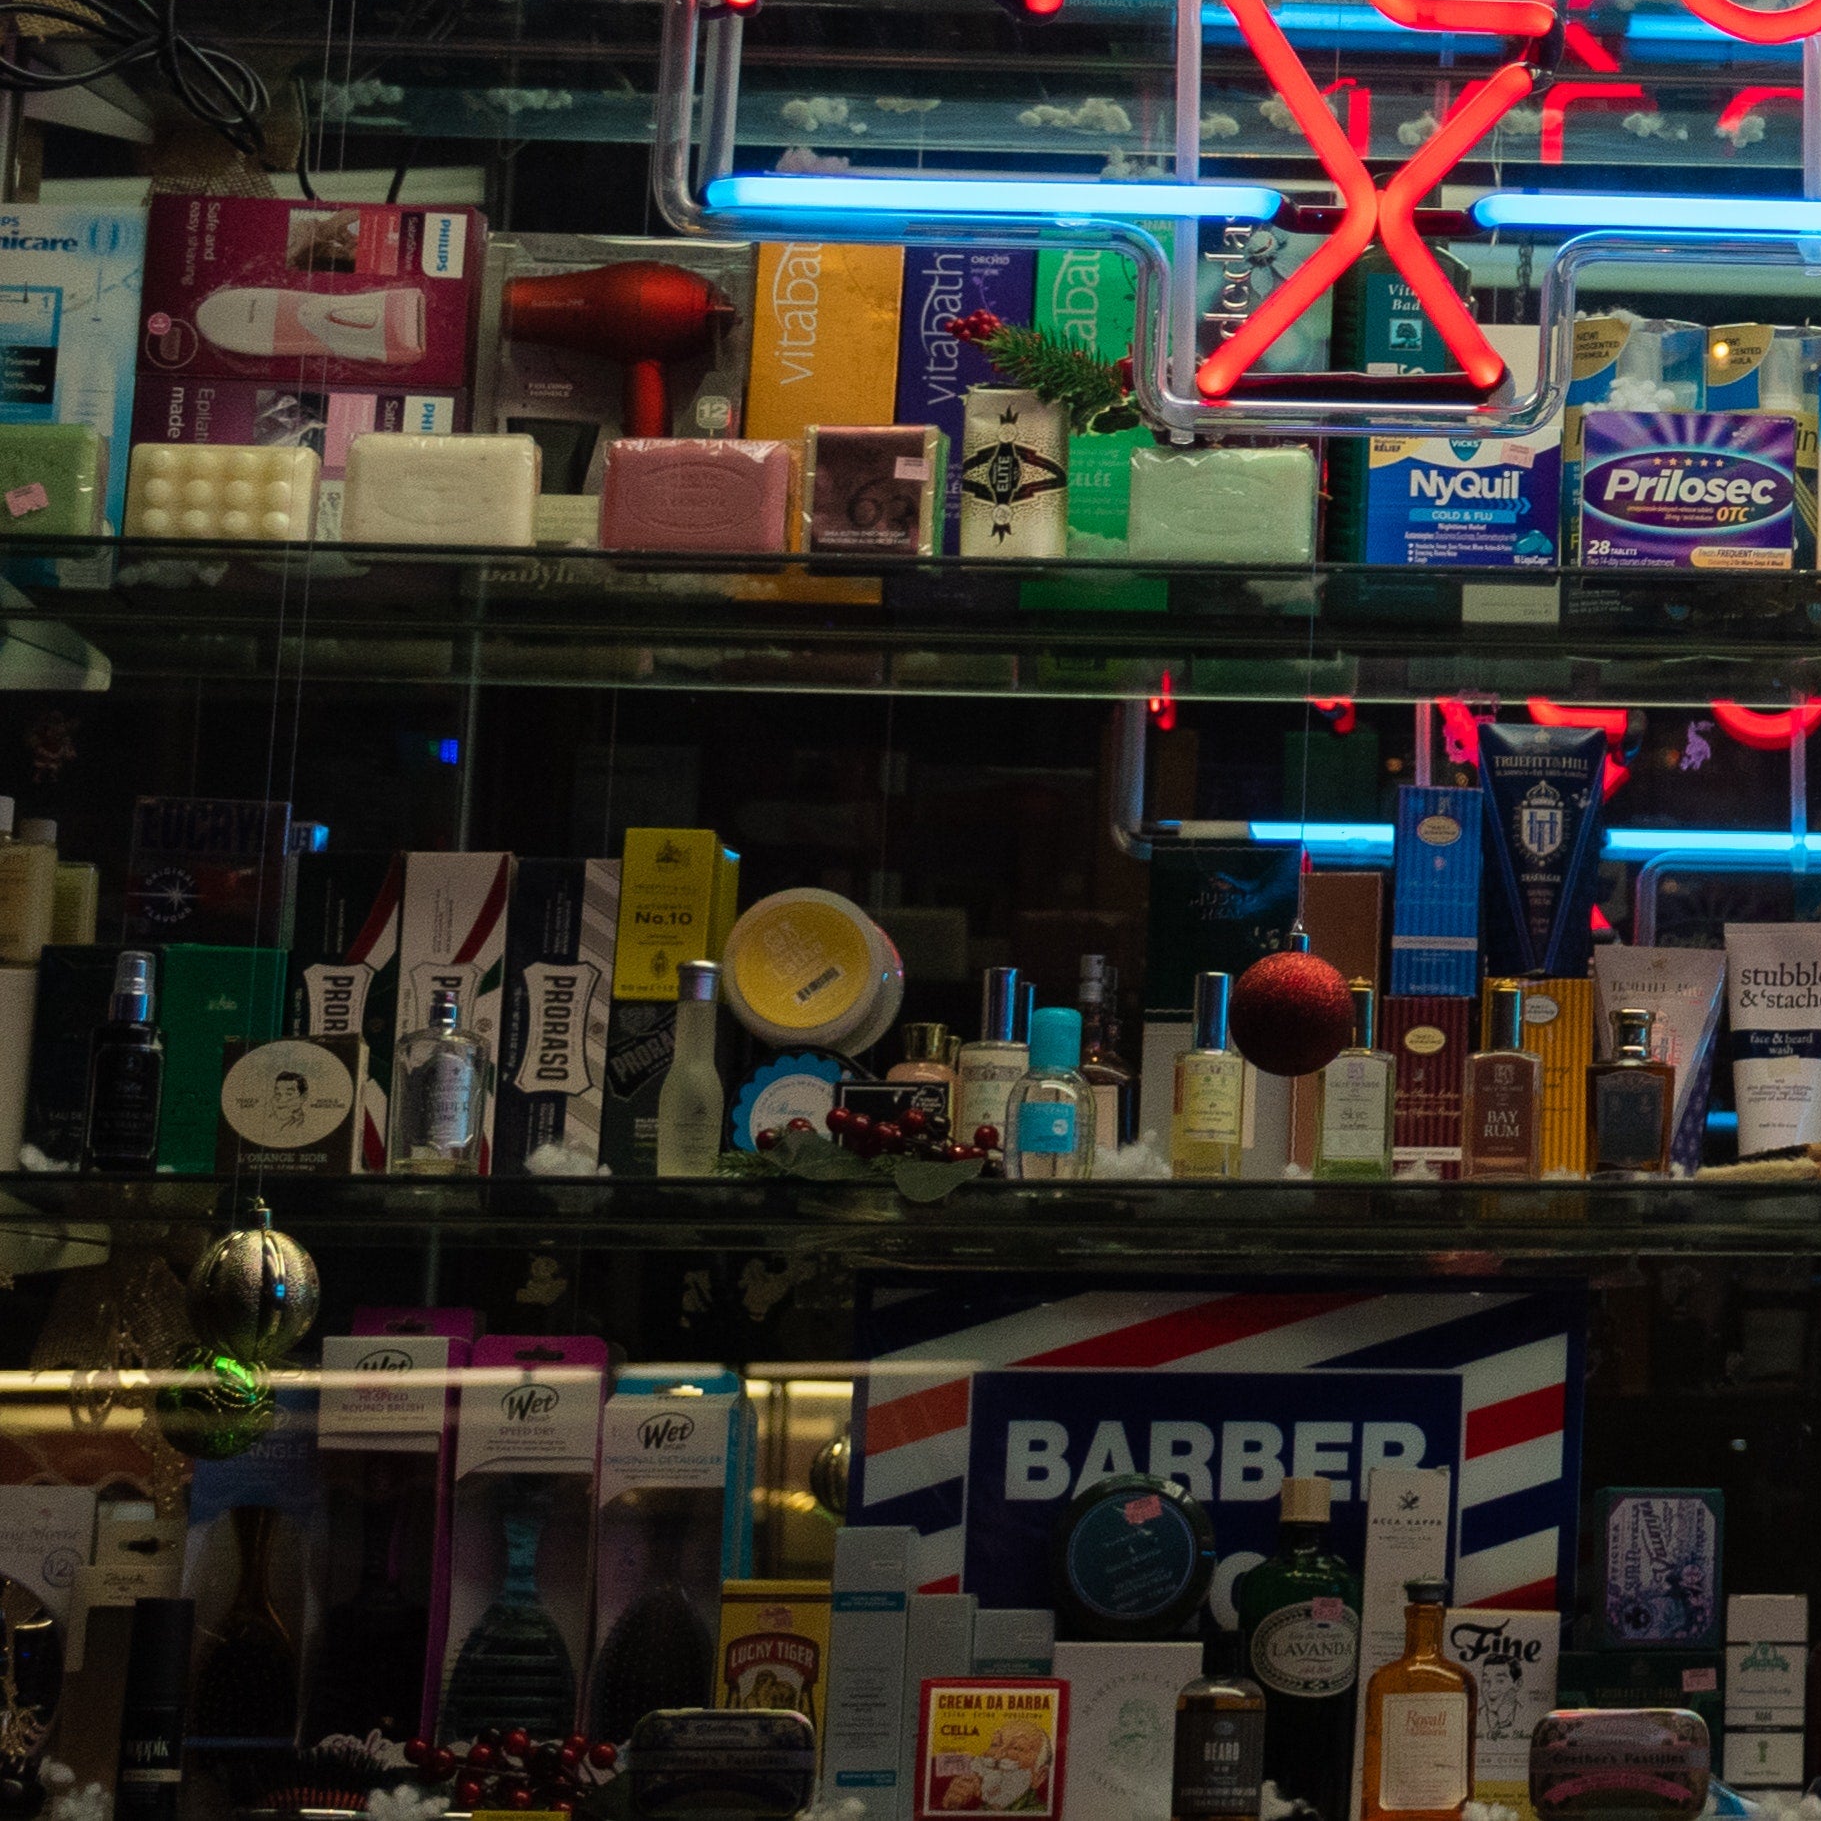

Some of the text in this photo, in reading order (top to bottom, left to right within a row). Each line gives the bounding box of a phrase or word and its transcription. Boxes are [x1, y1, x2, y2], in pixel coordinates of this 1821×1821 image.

[437, 219, 450, 272] PHILIPS
[920, 250, 966, 406] vitabath
[168, 387, 184, 439] made
[699, 403, 728, 419] 12
[997, 456, 1013, 494] ELITE
[1605, 469, 1776, 505] Prilosec
[1410, 469, 1520, 506] NyQuil
[1431, 510, 1493, 521] COLD & FLU
[1716, 507, 1749, 522] OTC
[1587, 540, 1610, 554] 28
[634, 912, 693, 928] No.10
[1740, 989, 1759, 1008] &
[537, 975, 577, 1083] PRORASO
[1487, 1110, 1518, 1125] BAY
[1485, 1124, 1520, 1139] RUM
[643, 1415, 695, 1447] Wet
[1003, 1419, 1429, 1503] BARBER
[730, 1639, 815, 1668] LUCKY TIGER
[1271, 1640, 1356, 1659] LAVANDA
[1450, 1619, 1542, 1664] Fine
[937, 1692, 1052, 1711] CREMA DA BARBA
[940, 1723, 982, 1738] CELLA
